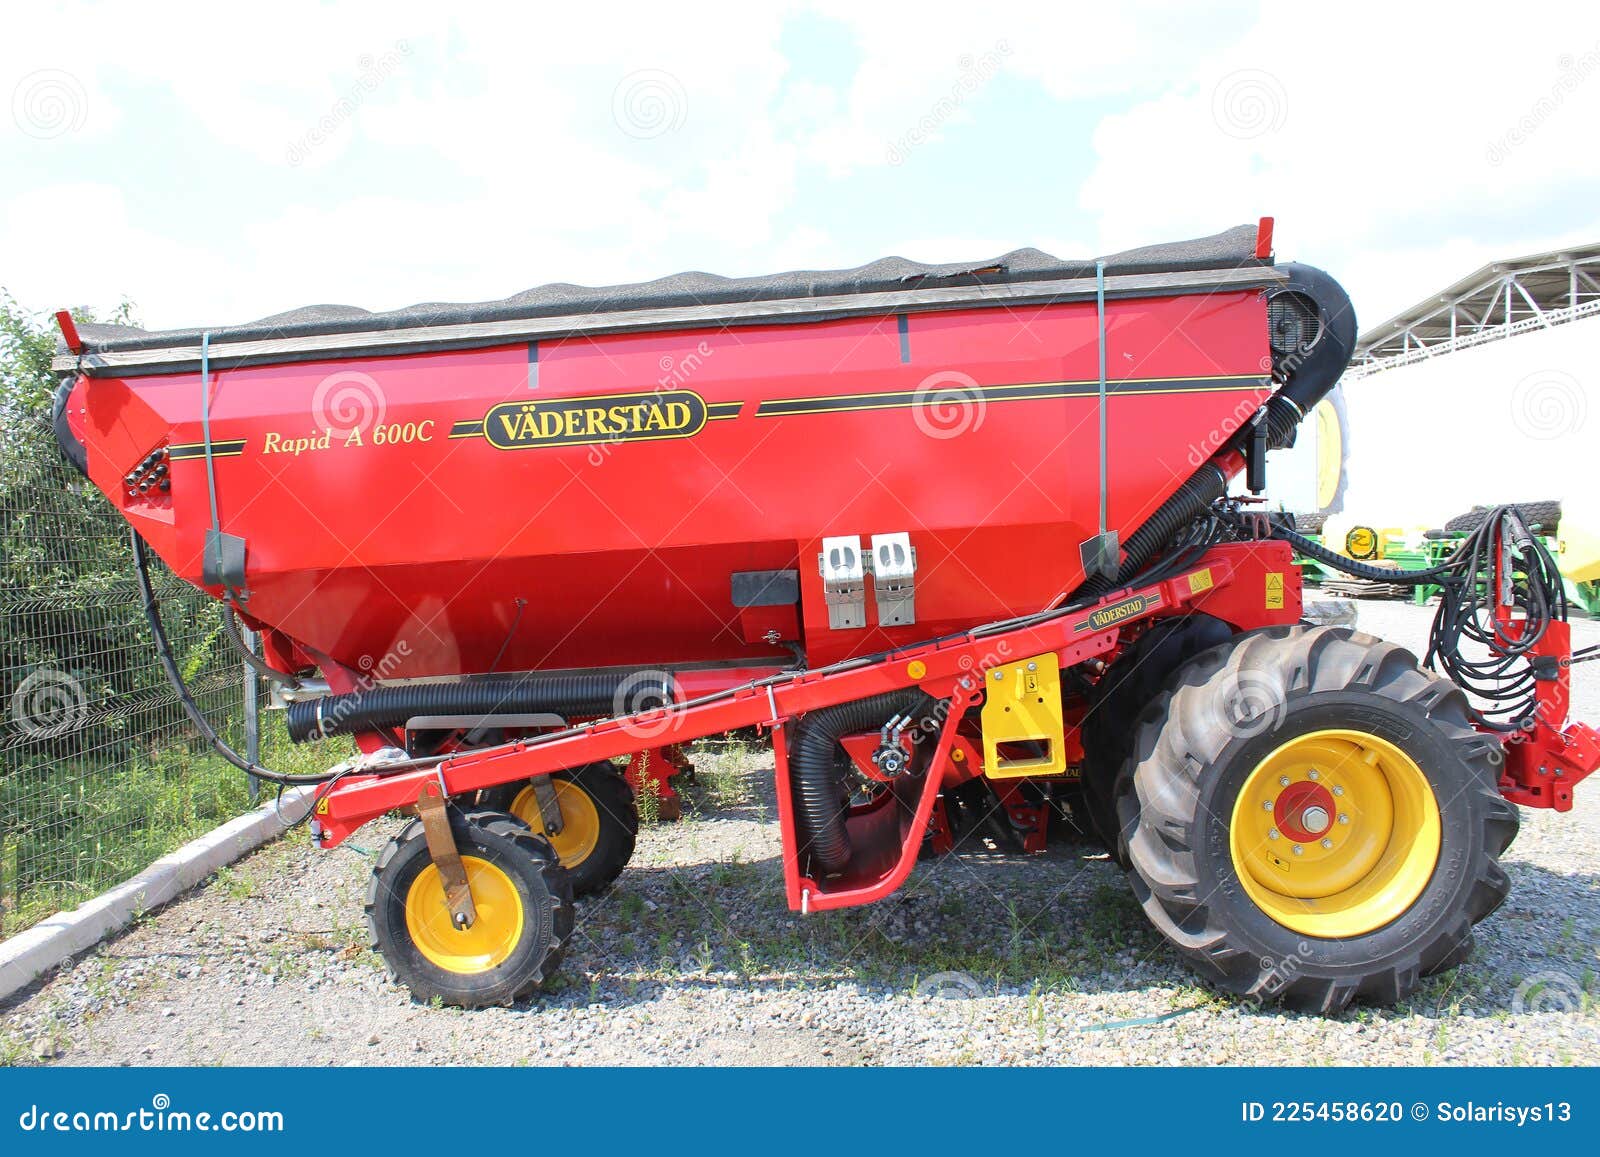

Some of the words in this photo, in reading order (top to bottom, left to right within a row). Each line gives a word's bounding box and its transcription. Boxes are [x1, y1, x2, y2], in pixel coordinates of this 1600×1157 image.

[262, 428, 332, 456] Rapid
[343, 425, 364, 448] A
[372, 419, 435, 446] 600C
[499, 402, 691, 441] VÄDERSTAD
[1093, 600, 1142, 626] VÄDERSTAD
